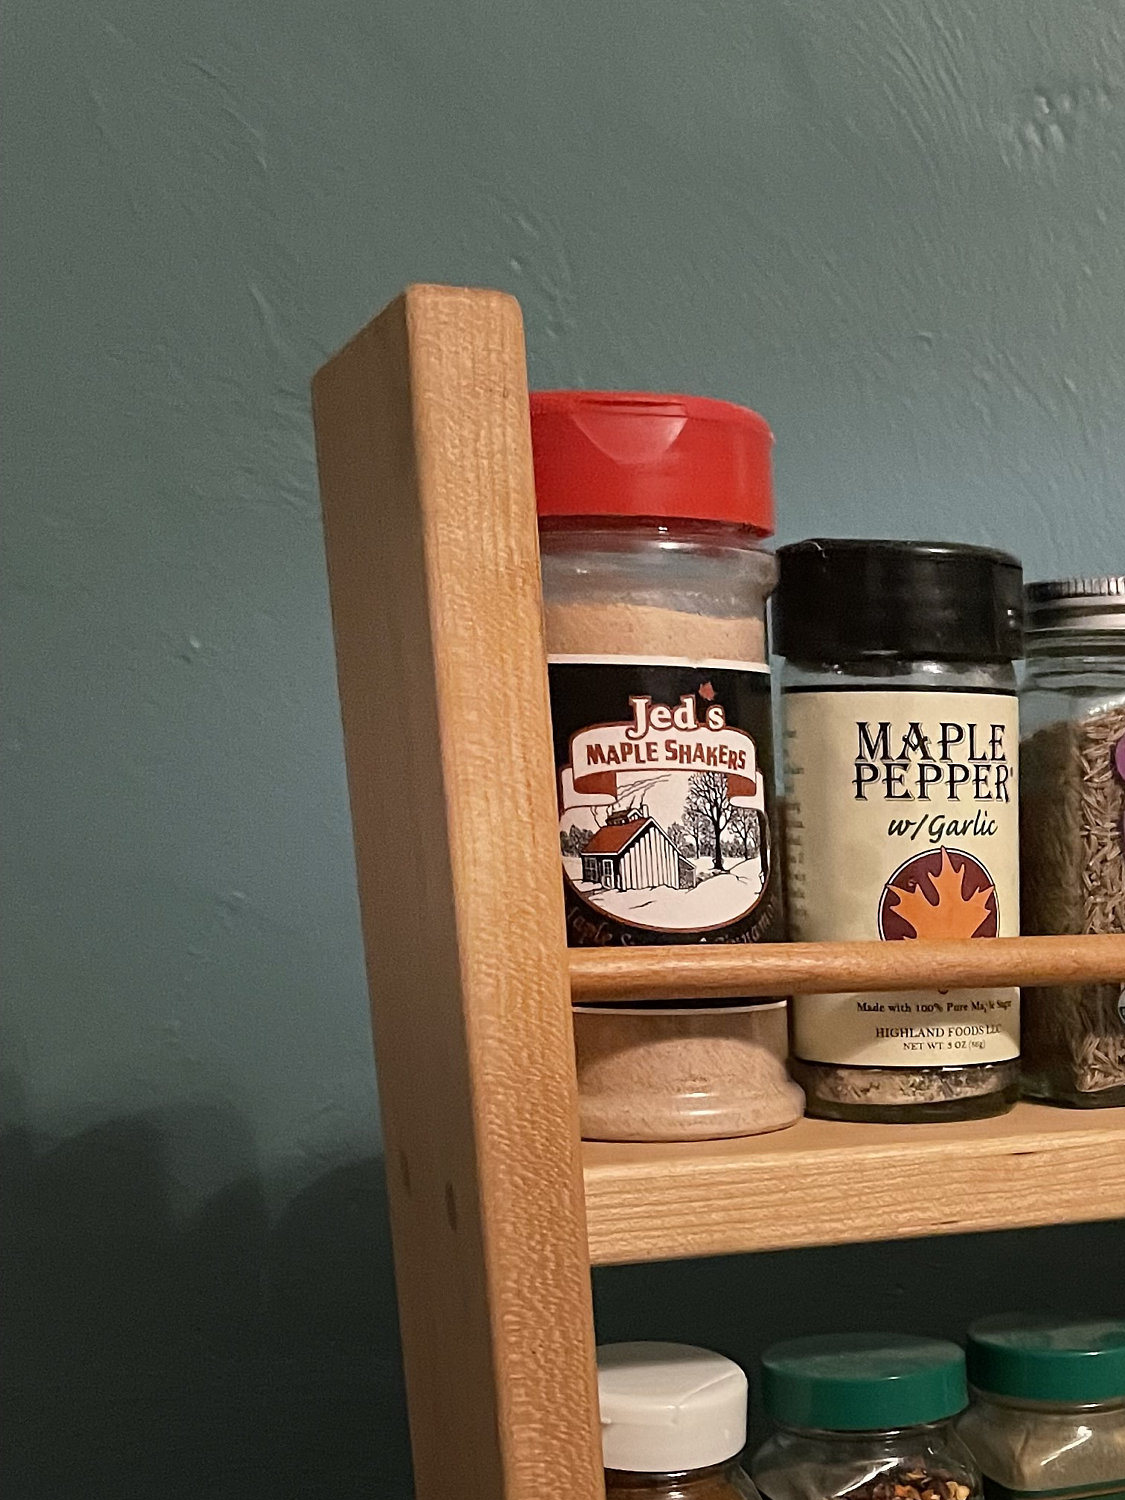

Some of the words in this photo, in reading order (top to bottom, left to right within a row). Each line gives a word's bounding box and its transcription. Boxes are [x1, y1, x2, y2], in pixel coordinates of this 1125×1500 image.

[625, 694, 726, 740] Jed's
[587, 740, 658, 766] MAPLE
[665, 739, 747, 771] SHAKERS
[856, 721, 1007, 762] MAPLE
[852, 762, 1010, 803] PEPPER
[888, 809, 998, 844] w/Garlic
[857, 1001, 884, 1012] Made
[888, 1002, 911, 1012] with
[916, 1003, 943, 1013] 100%
[947, 1001, 967, 1012] Pure
[875, 1026, 945, 1038] HIGHLAND
[948, 1025, 984, 1036] FOODS
[986, 1024, 1002, 1034] LLC
[903, 1042, 924, 1050] NET
[927, 1041, 944, 1050] WT
[954, 1040, 966, 1049] OZ
